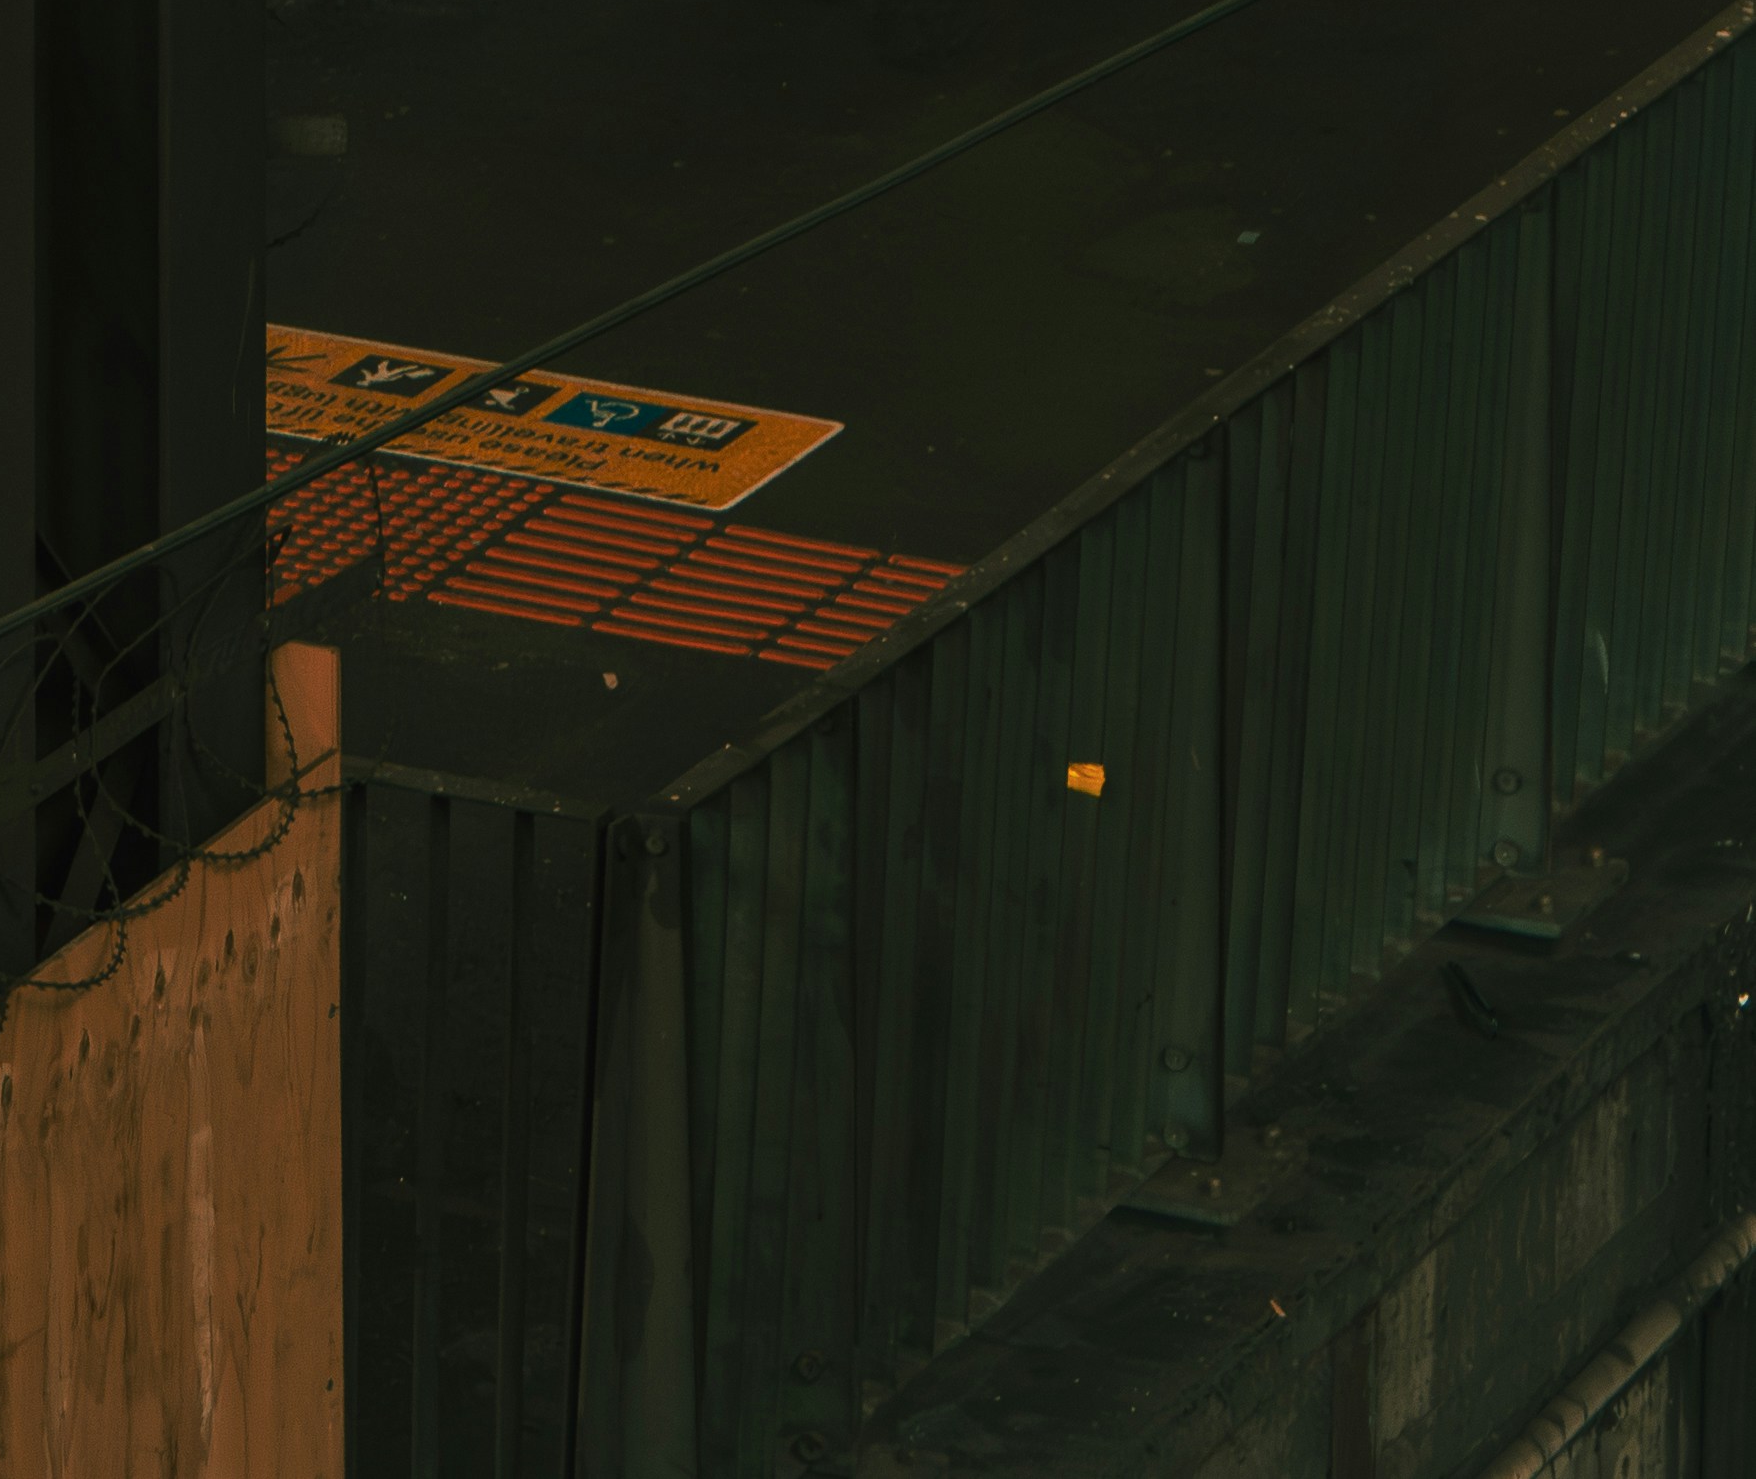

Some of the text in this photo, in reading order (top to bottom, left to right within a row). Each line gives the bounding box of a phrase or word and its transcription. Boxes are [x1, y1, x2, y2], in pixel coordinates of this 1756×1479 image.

[333, 412, 383, 432] he
[414, 426, 473, 447] use
[432, 411, 610, 454] travelling
[477, 437, 608, 471] Please
[615, 444, 721, 474] when
